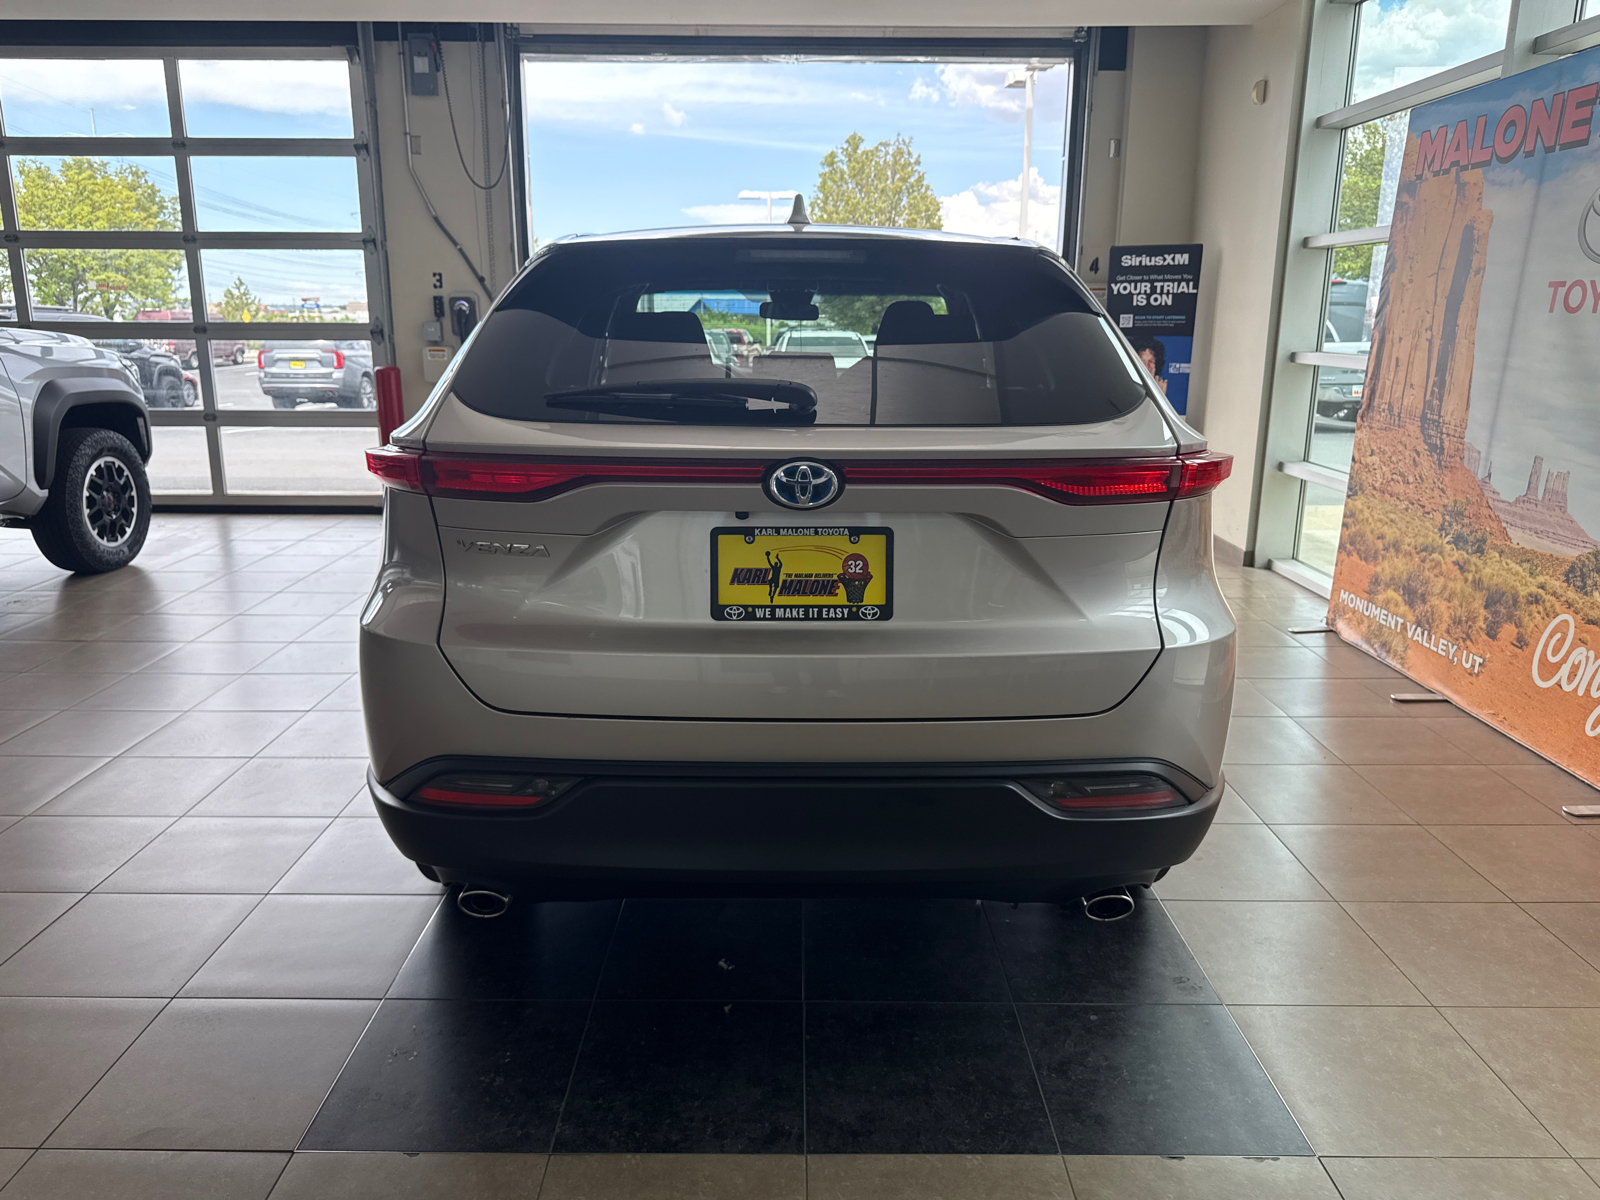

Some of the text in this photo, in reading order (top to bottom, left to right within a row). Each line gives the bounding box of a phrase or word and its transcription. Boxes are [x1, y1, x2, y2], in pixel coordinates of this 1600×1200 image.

[1414, 82, 1599, 180] MALONE
[1089, 257, 1099, 274] 4
[1121, 253, 1189, 267] SiriusXM
[432, 272, 443, 289] 3
[1110, 281, 1198, 295] YOUR TRIAL
[1132, 294, 1173, 306] IS ON
[754, 528, 850, 536] KARL MALONE TOYOTA
[456, 540, 550, 557] VENZA
[847, 560, 863, 573] 32
[729, 567, 772, 585] KARL
[777, 579, 840, 597] MALONE
[755, 608, 849, 619] WE MAKE IT EASY
[1339, 589, 1483, 674] MONUMENT VALLEY, UT
